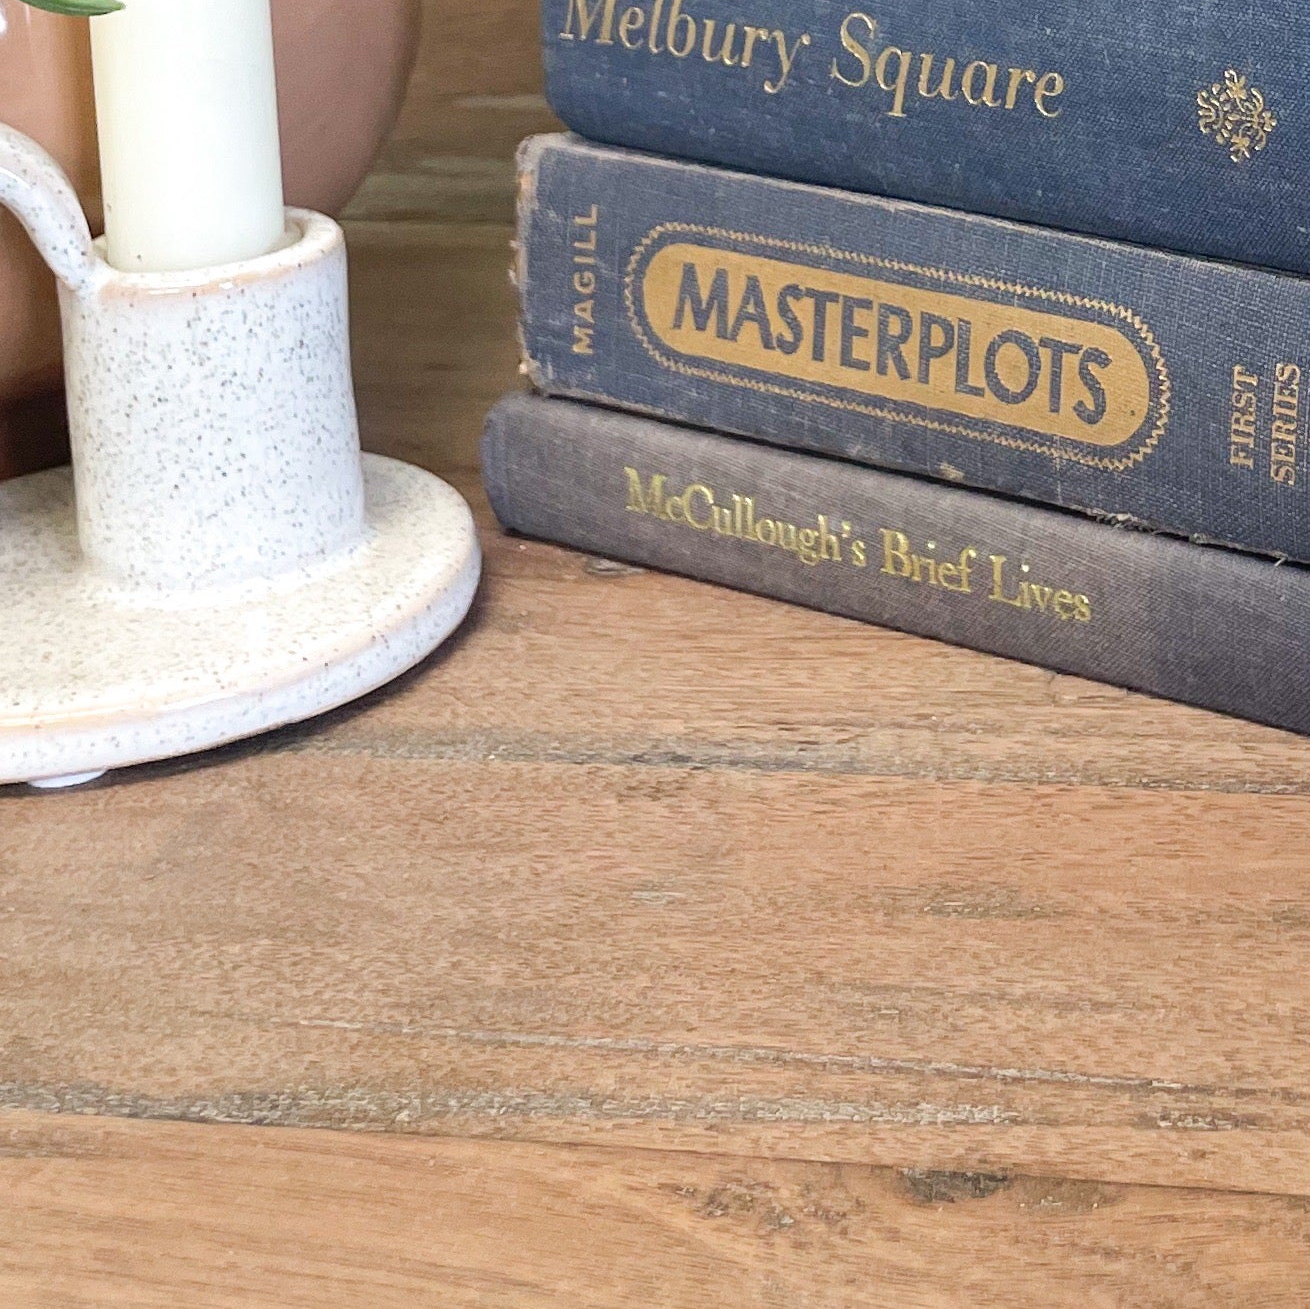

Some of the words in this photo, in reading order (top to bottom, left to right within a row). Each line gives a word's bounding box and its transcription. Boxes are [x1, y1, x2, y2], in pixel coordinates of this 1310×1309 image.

[830, 12, 1066, 118] Square
[572, 203, 599, 355] MAGILL
[672, 262, 1113, 425] MASTERPLOTS
[1229, 364, 1259, 470] FIRST
[1270, 362, 1301, 486] SERIES
[622, 466, 868, 569] McCullough's
[878, 527, 976, 594] Brief
[986, 553, 1093, 623] Lives
